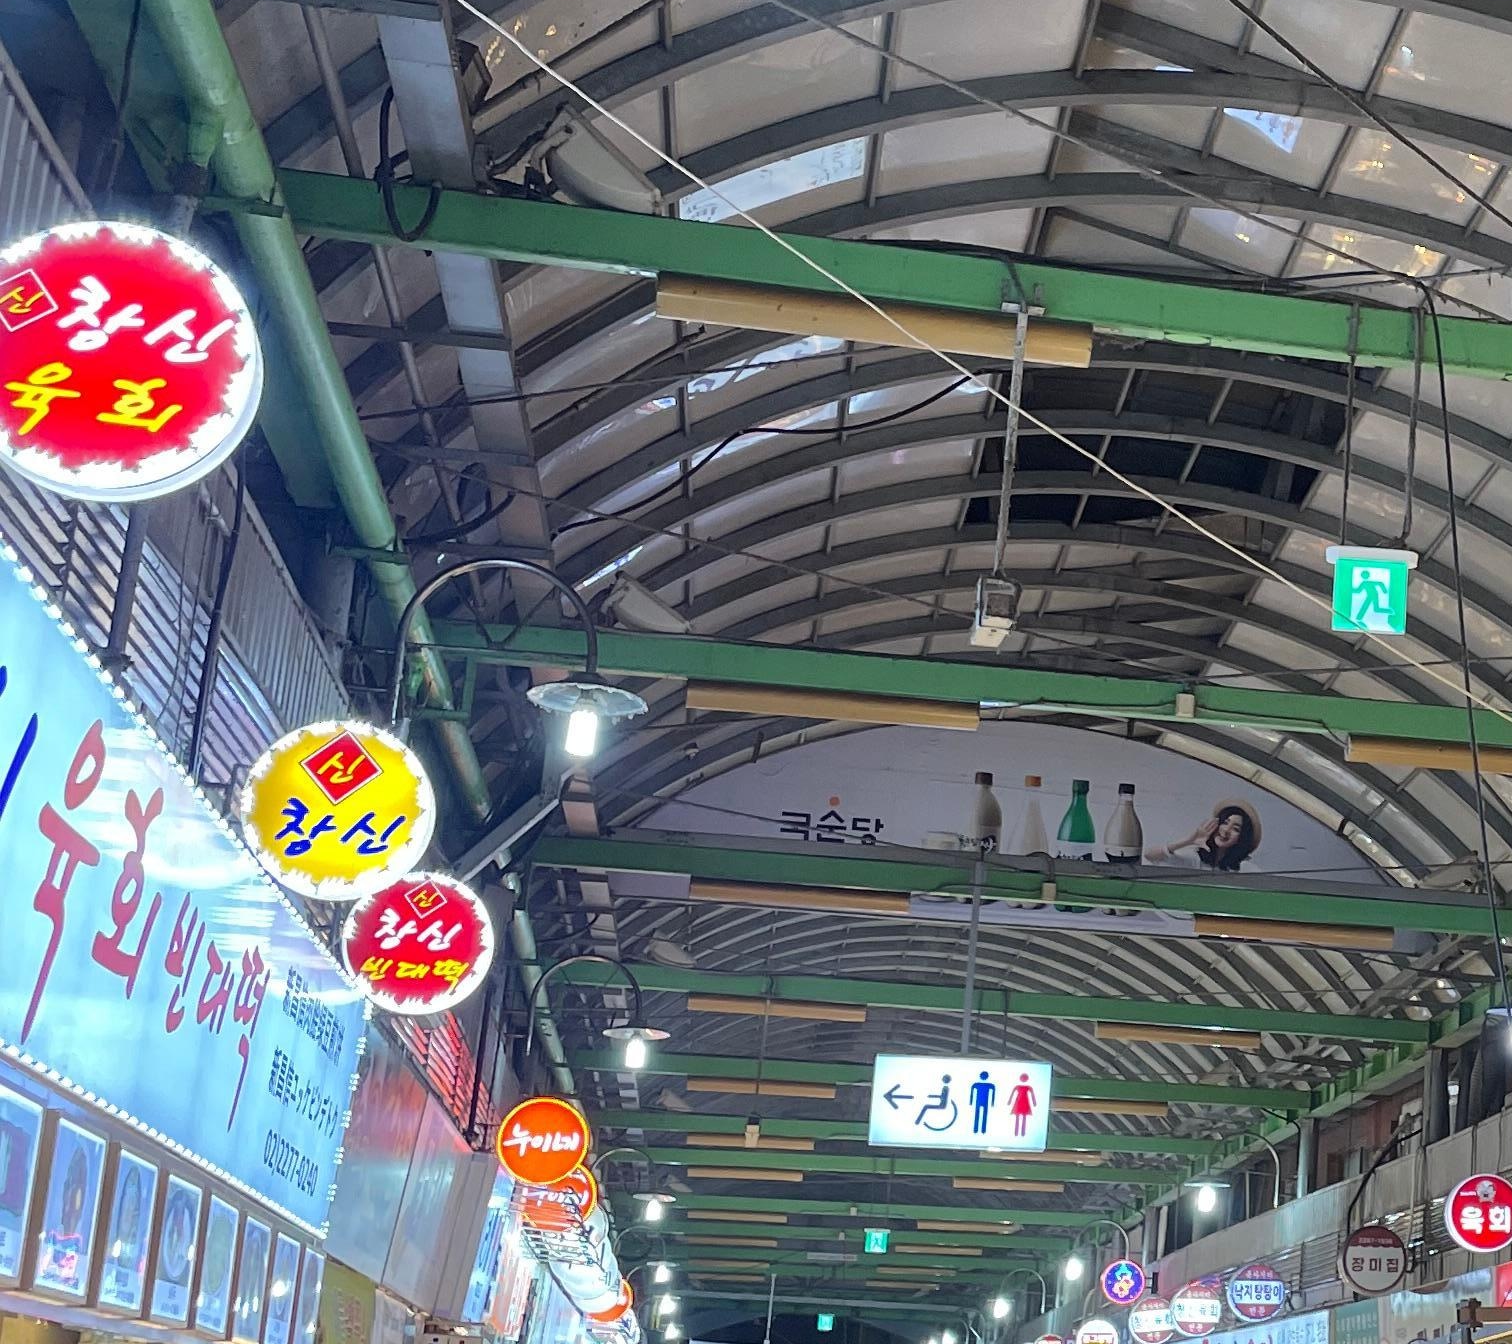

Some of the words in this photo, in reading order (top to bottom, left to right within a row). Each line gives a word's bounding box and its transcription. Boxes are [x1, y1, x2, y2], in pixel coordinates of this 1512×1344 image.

[0, 285, 46, 314] 신
[57, 275, 236, 364] 창신
[4, 361, 184, 436] 육회
[317, 751, 366, 784] 신
[274, 797, 407, 857] 창신
[779, 809, 885, 846] 국순당
[374, 908, 463, 951] 창신
[360, 956, 468, 991] 빈대떡
[1460, 1205, 1511, 1235] 육회
[1351, 1257, 1399, 1273] 장미집
[1234, 1283, 1282, 1301] 낙지탕탕이
